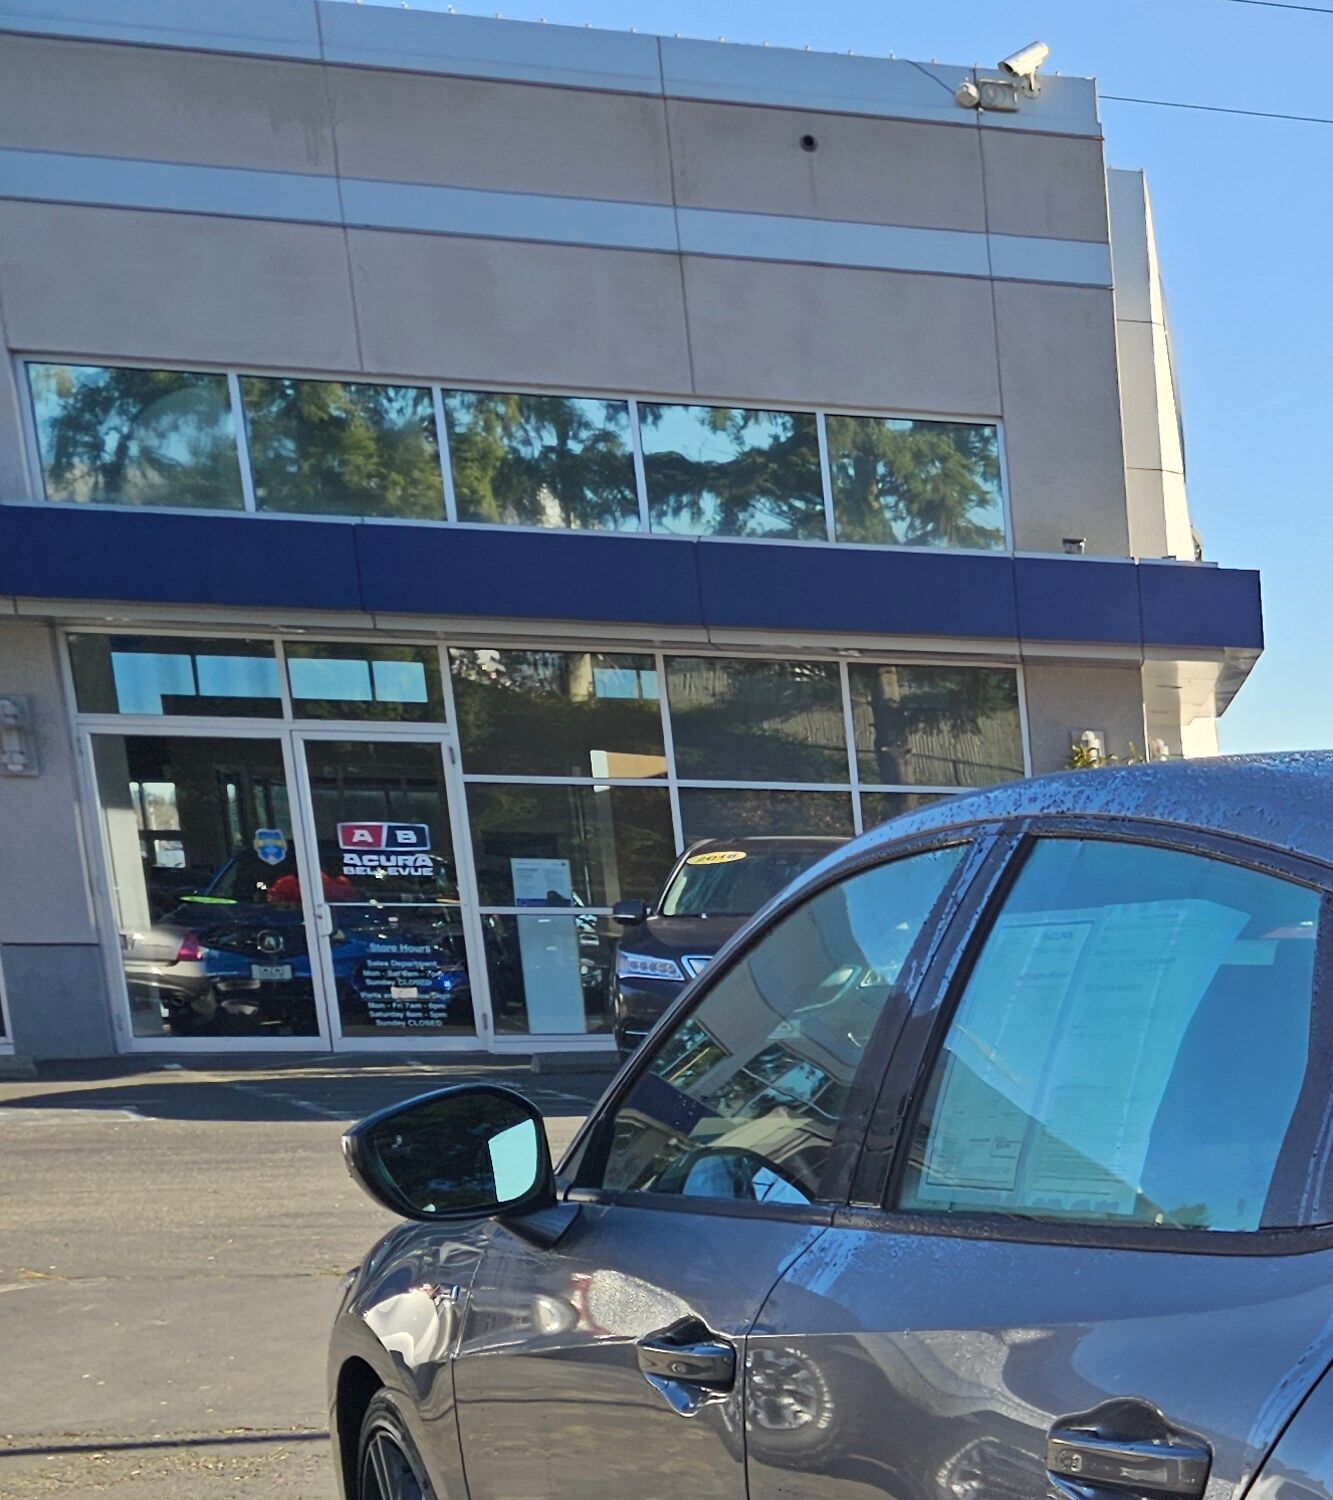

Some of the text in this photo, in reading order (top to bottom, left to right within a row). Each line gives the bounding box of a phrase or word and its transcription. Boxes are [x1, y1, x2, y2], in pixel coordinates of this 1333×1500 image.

[352, 829, 417, 844] A B
[342, 853, 434, 867] ACURA
[369, 943, 431, 953] Store Hours
